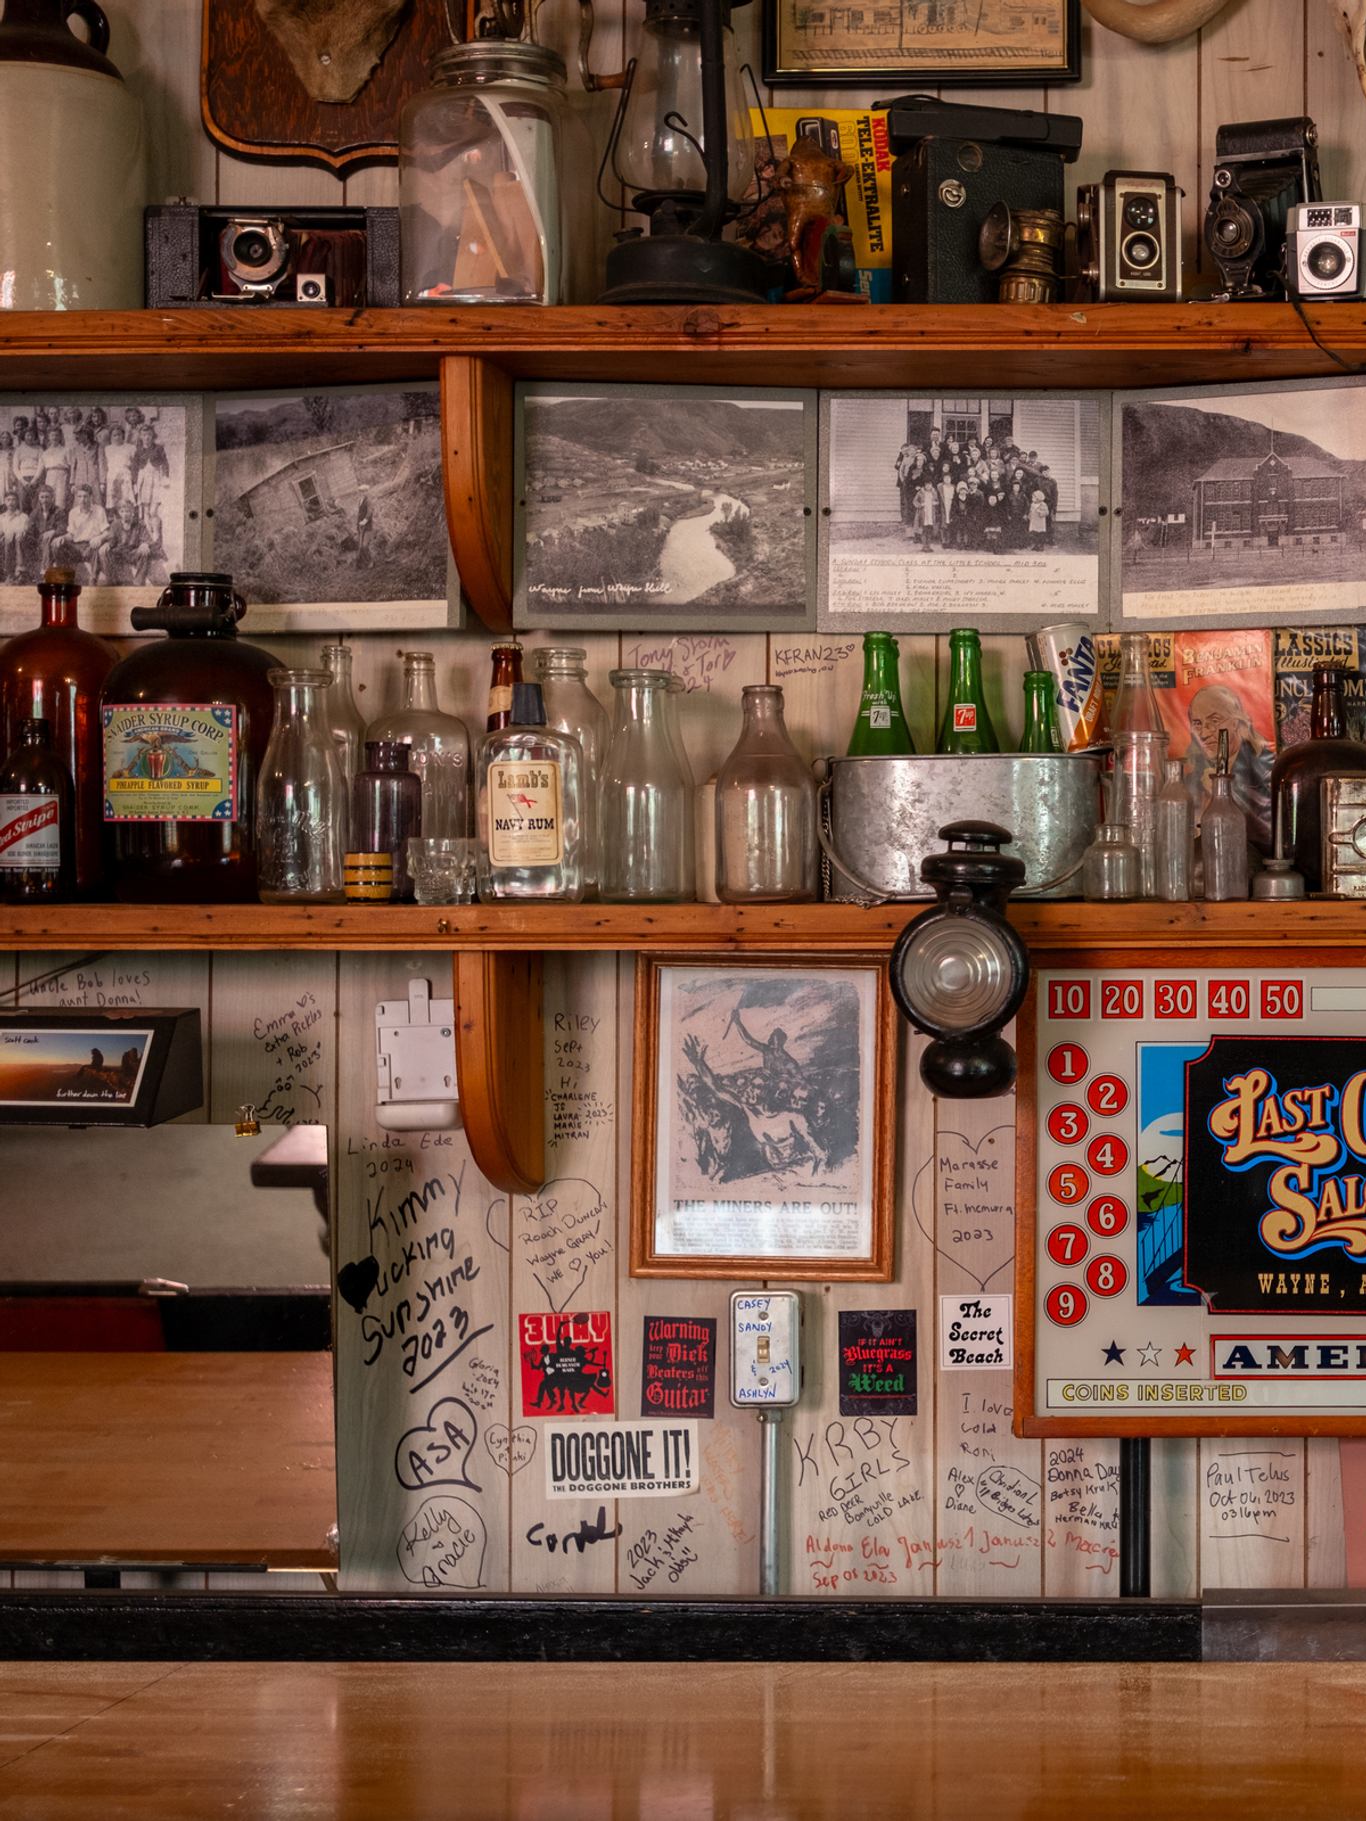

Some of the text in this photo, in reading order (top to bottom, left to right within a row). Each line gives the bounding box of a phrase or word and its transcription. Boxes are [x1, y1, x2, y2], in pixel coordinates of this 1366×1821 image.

[872, 117, 891, 173] KODAK
[857, 115, 884, 253] TELE-EKTRALITE
[1182, 641, 1264, 667] BENJAMIN
[1057, 635, 1096, 714] FANTA
[1182, 656, 1264, 685] FRANKLIN
[149, 713, 226, 745] SYRUP CORP.
[115, 781, 210, 790] PINEAPPLE FLAVORED SYRUP
[498, 772, 548, 790] Lamb's
[13, 808, 55, 836] Stripe
[494, 818, 555, 831] NAVY RUM
[77, 968, 151, 990] Bob loves
[1053, 985, 1085, 1015] 10
[1105, 985, 1140, 1015] 20
[1158, 984, 1193, 1014] 30
[1211, 985, 1247, 1015] 40
[1265, 985, 1300, 1015] 50
[554, 1013, 600, 1032] Riley
[287, 1043, 309, 1062] Rob
[557, 1057, 591, 1073] 2023
[1060, 1050, 1076, 1077] 1
[551, 1091, 598, 1101] CHARLENE
[1099, 1082, 1118, 1109] 2
[554, 1113, 579, 1121] LAURA
[554, 1122, 583, 1130] MARIE
[1059, 1111, 1079, 1139] 3
[1210, 1067, 1340, 1167] LAST
[347, 1133, 454, 1156] Linda Ede
[939, 1156, 999, 1173] Marasse
[1095, 1142, 1115, 1169] 4
[366, 1159, 415, 1179] 2024
[944, 1176, 989, 1193] Family
[1059, 1172, 1077, 1199] 5
[519, 1199, 558, 1223] RIP
[672, 1200, 858, 1215] THE MINERS ARE OUT!
[1098, 1202, 1117, 1230] 6
[951, 1228, 994, 1242] 2023
[1058, 1232, 1076, 1260] 7
[525, 1249, 566, 1267] Wayne
[1097, 1261, 1115, 1290] 8
[736, 1299, 771, 1311] CASEY
[958, 1299, 992, 1319] The
[1057, 1290, 1076, 1319] 9
[648, 1319, 710, 1345] Warning
[738, 1321, 772, 1333] SANDY
[949, 1321, 1005, 1345] Secret
[401, 1305, 470, 1377] 2023
[858, 1337, 903, 1347] IF IT AIN'T
[666, 1342, 709, 1363] Dick
[843, 1345, 913, 1366] Bluegrass
[948, 1349, 1004, 1364] Beach
[647, 1363, 696, 1381] Beaters
[768, 1359, 793, 1375] 2024
[863, 1363, 894, 1374] IT'S A
[738, 1383, 777, 1399] ASHLYN
[847, 1373, 905, 1394] Weed
[1061, 1384, 1248, 1402] COINS INSERTED
[646, 1381, 709, 1409] Guitar
[408, 1421, 470, 1484] ASA
[551, 1431, 653, 1483] DOGGONE
[662, 1428, 692, 1480] IT!
[793, 1417, 900, 1487] KRBY
[1049, 1447, 1084, 1466] 2024
[829, 1449, 911, 1502] GIRLS
[947, 1467, 976, 1486] Alex
[1047, 1467, 1095, 1483] Donna
[1206, 1462, 1241, 1488] Paul
[552, 1480, 692, 1493] THE DOGGONE BROTHERS
[818, 1494, 863, 1523] RED DEER
[944, 1496, 978, 1515] Diane
[1208, 1488, 1296, 1508] Oct 2023
[866, 1506, 894, 1527] COLD
[626, 1528, 658, 1570] 2023
